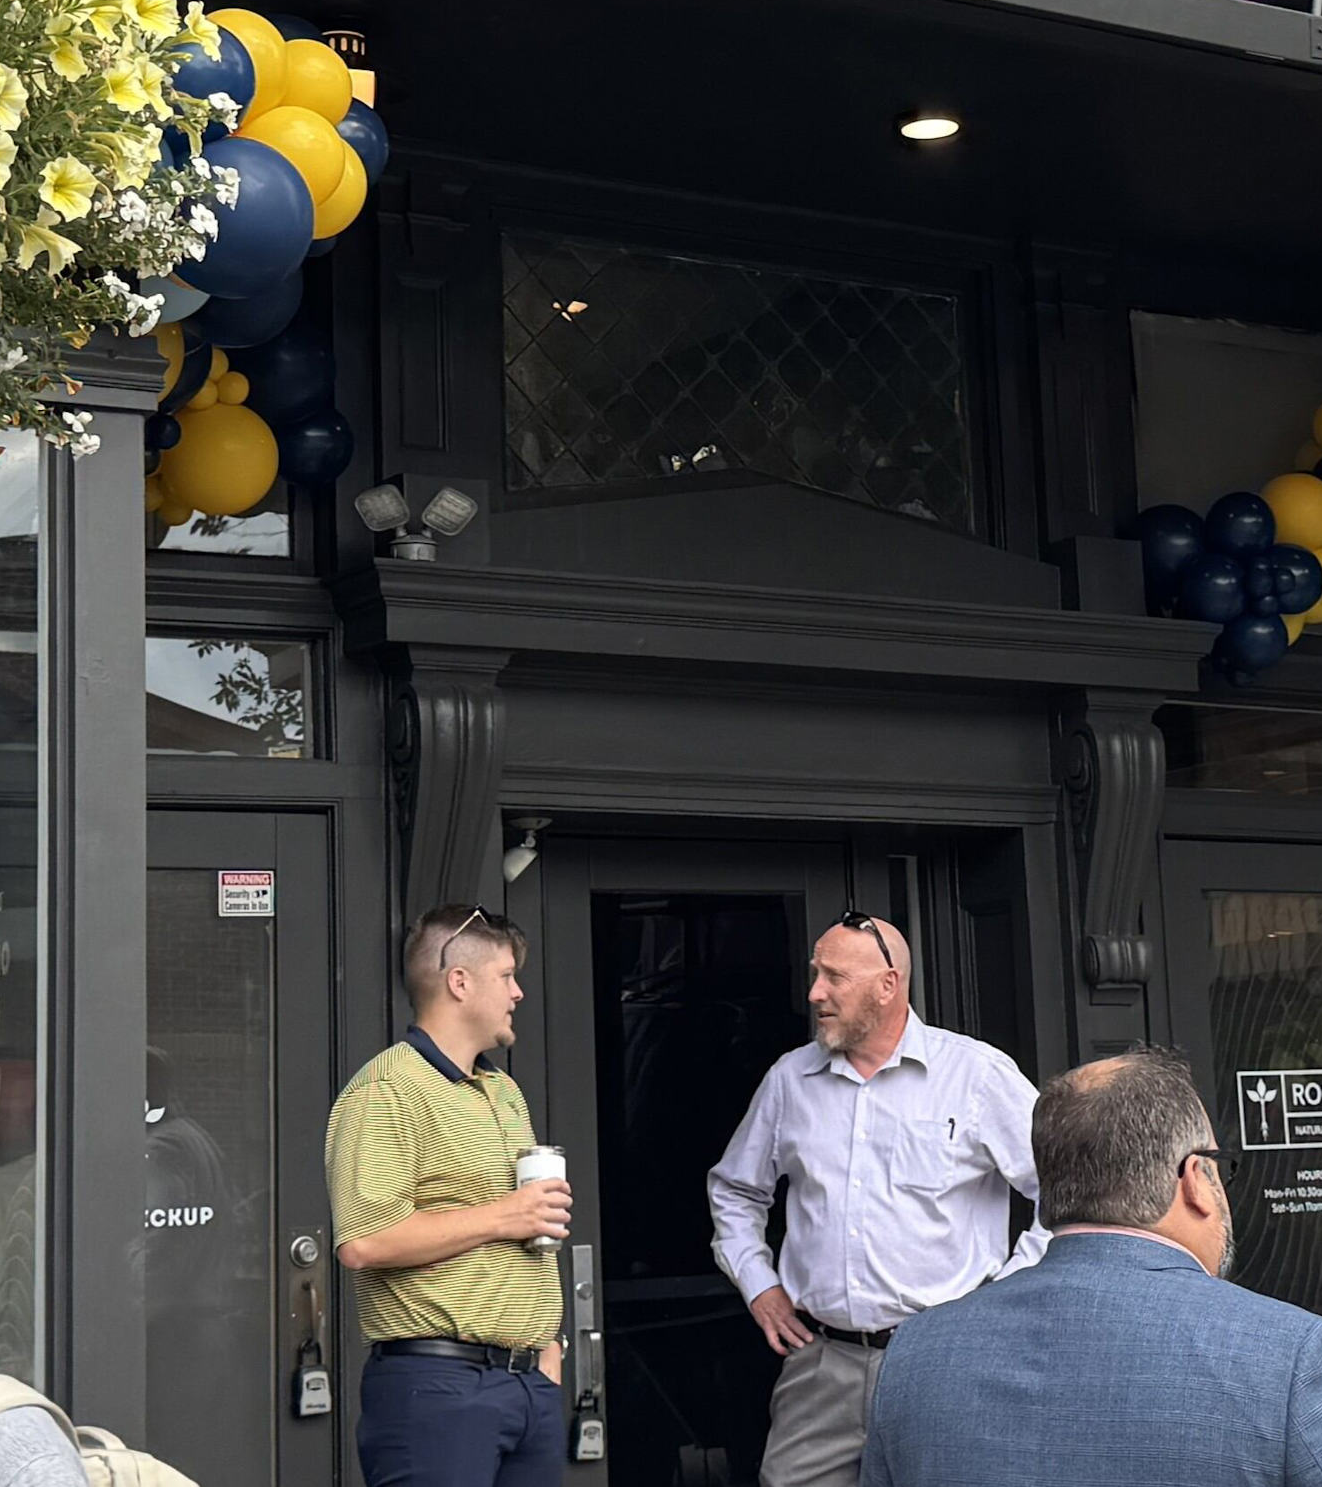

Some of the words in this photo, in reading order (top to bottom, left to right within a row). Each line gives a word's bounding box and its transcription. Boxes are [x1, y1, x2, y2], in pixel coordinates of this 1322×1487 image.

[223, 874, 269, 885] WARNING
[225, 889, 250, 900] Security
[144, 1206, 214, 1228] CKUP
